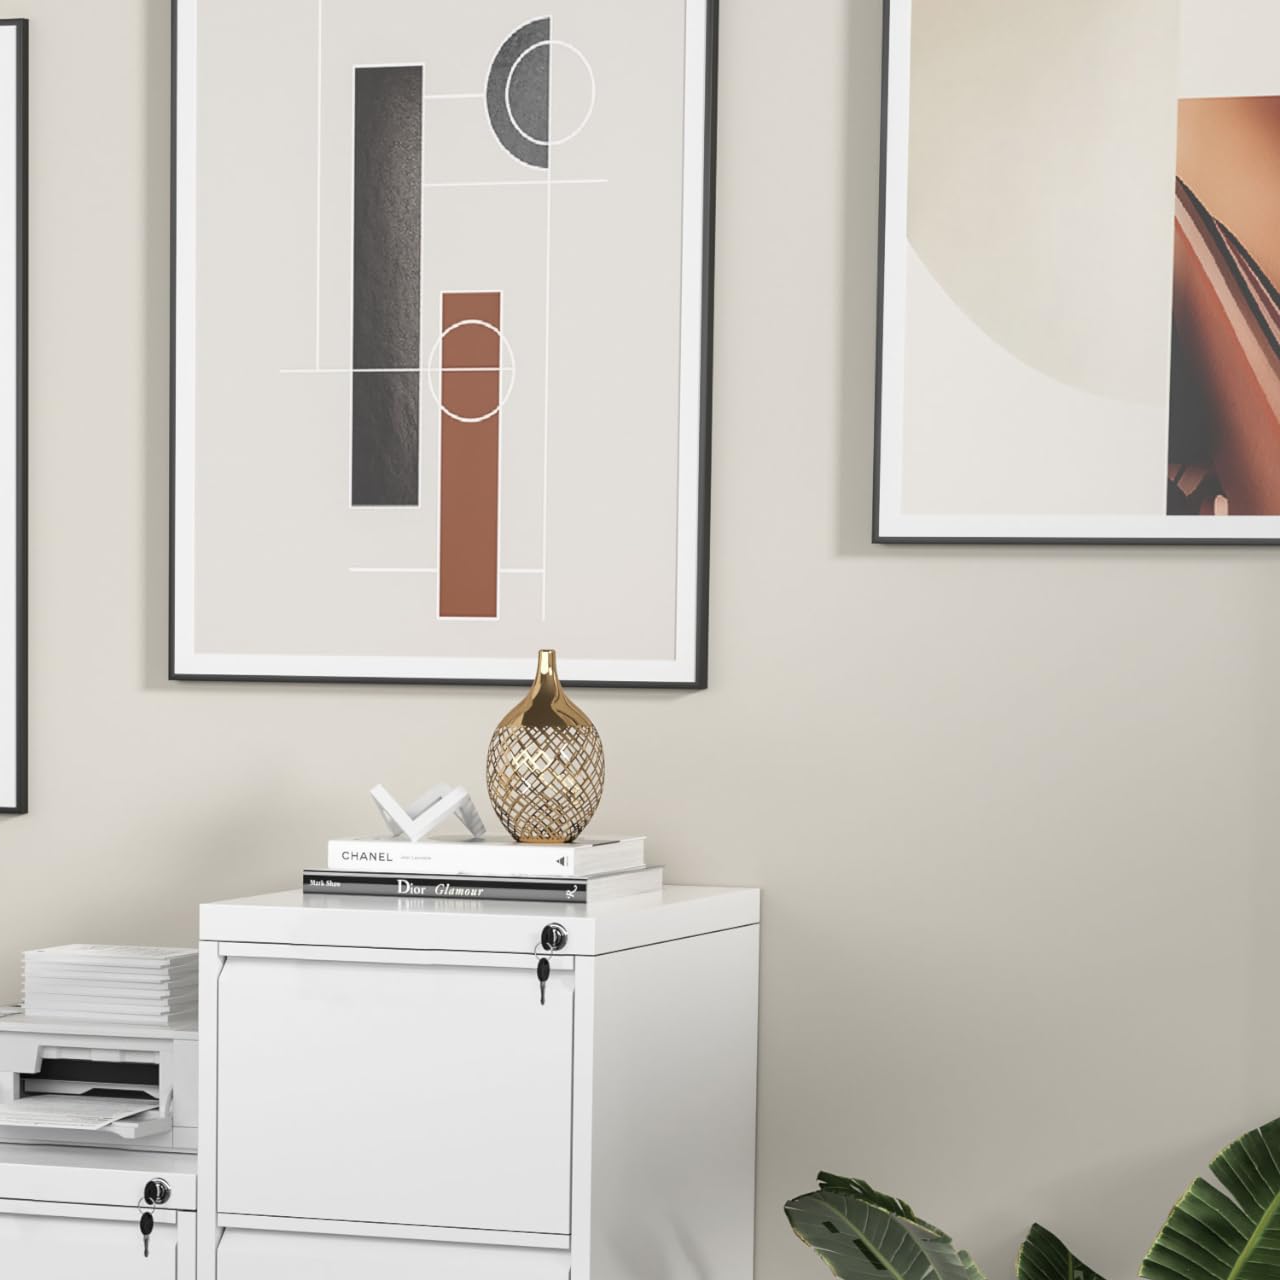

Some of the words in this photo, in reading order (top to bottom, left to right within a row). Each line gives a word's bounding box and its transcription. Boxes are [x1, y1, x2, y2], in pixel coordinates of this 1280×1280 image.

[341, 851, 393, 862] CHANEL
[310, 879, 325, 887] Mark
[326, 879, 341, 887] Shaw
[397, 879, 426, 895] Dior
[434, 883, 484, 897] Glamour
